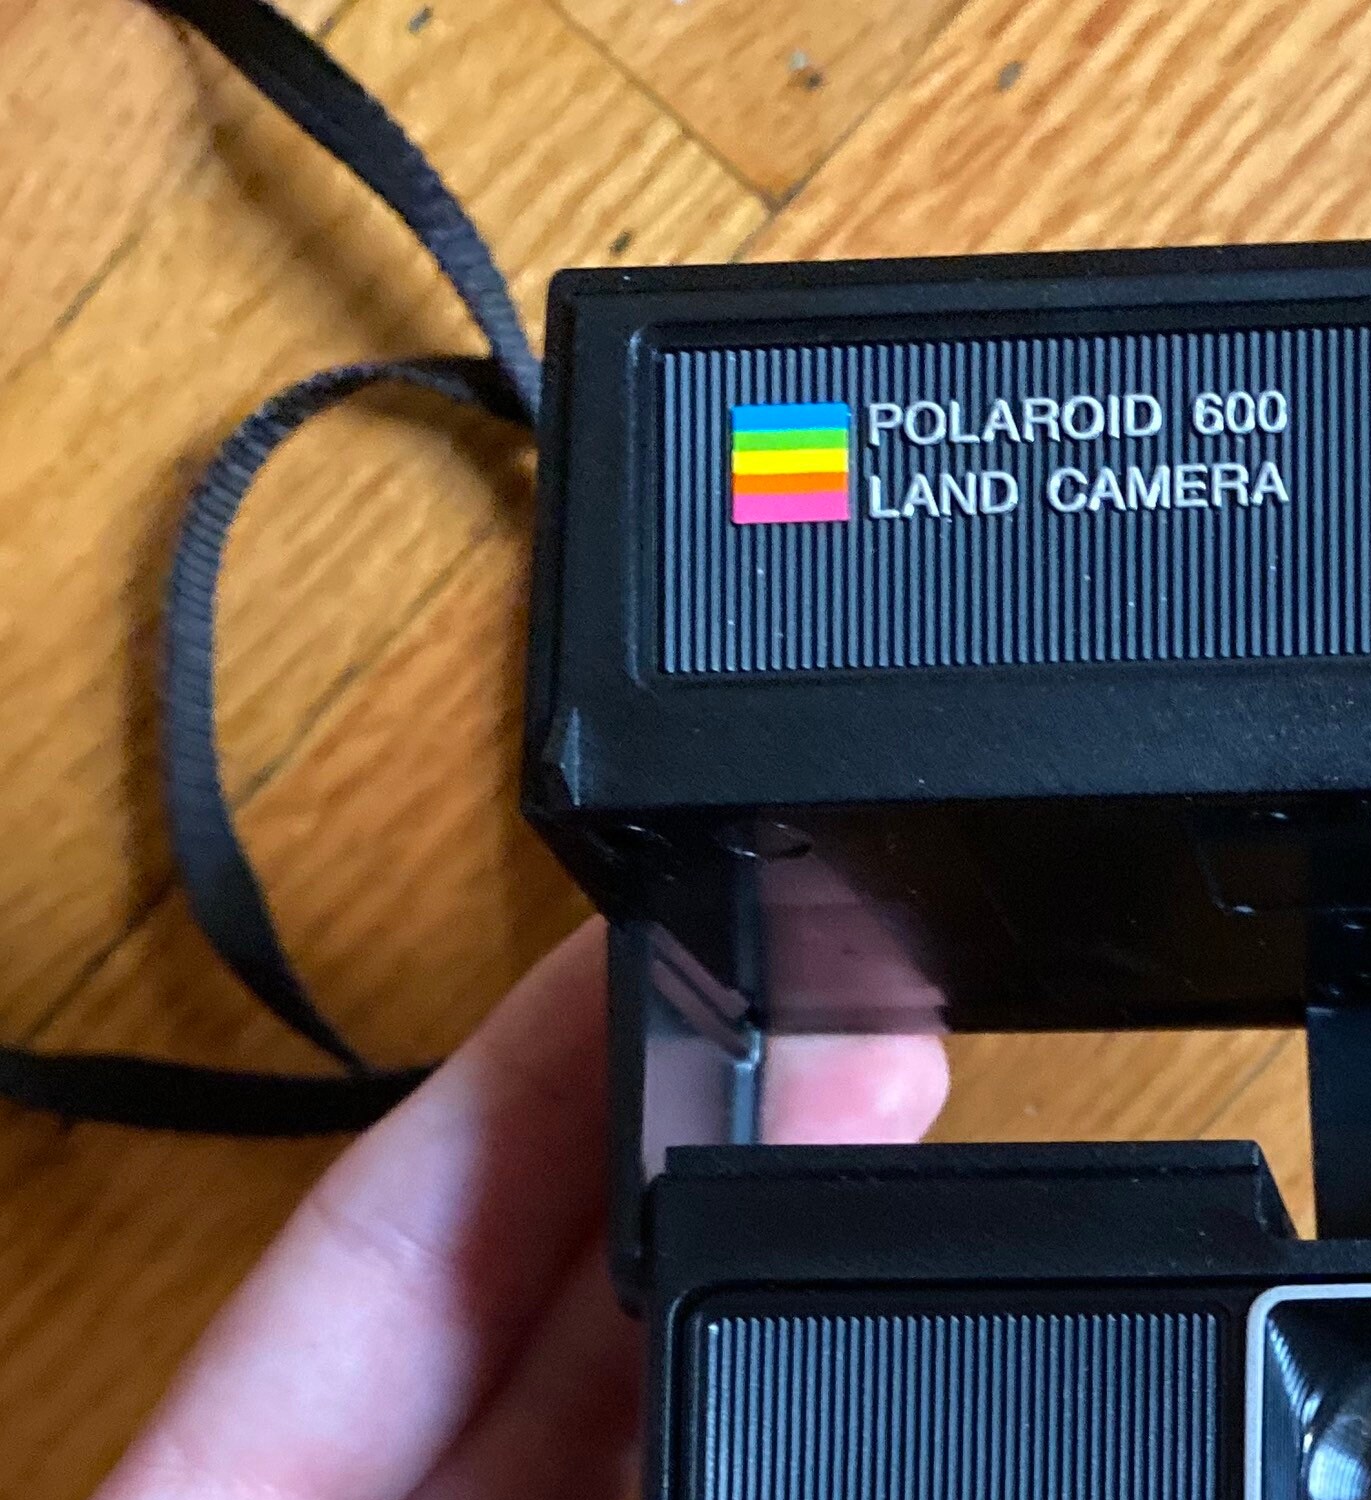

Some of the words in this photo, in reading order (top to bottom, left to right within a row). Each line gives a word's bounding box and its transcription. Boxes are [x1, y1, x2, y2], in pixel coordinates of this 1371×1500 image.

[868, 395, 1163, 446] POLAROID
[1193, 390, 1289, 437] 600
[868, 471, 1019, 519] LAND
[1047, 461, 1290, 513] CAMERA
